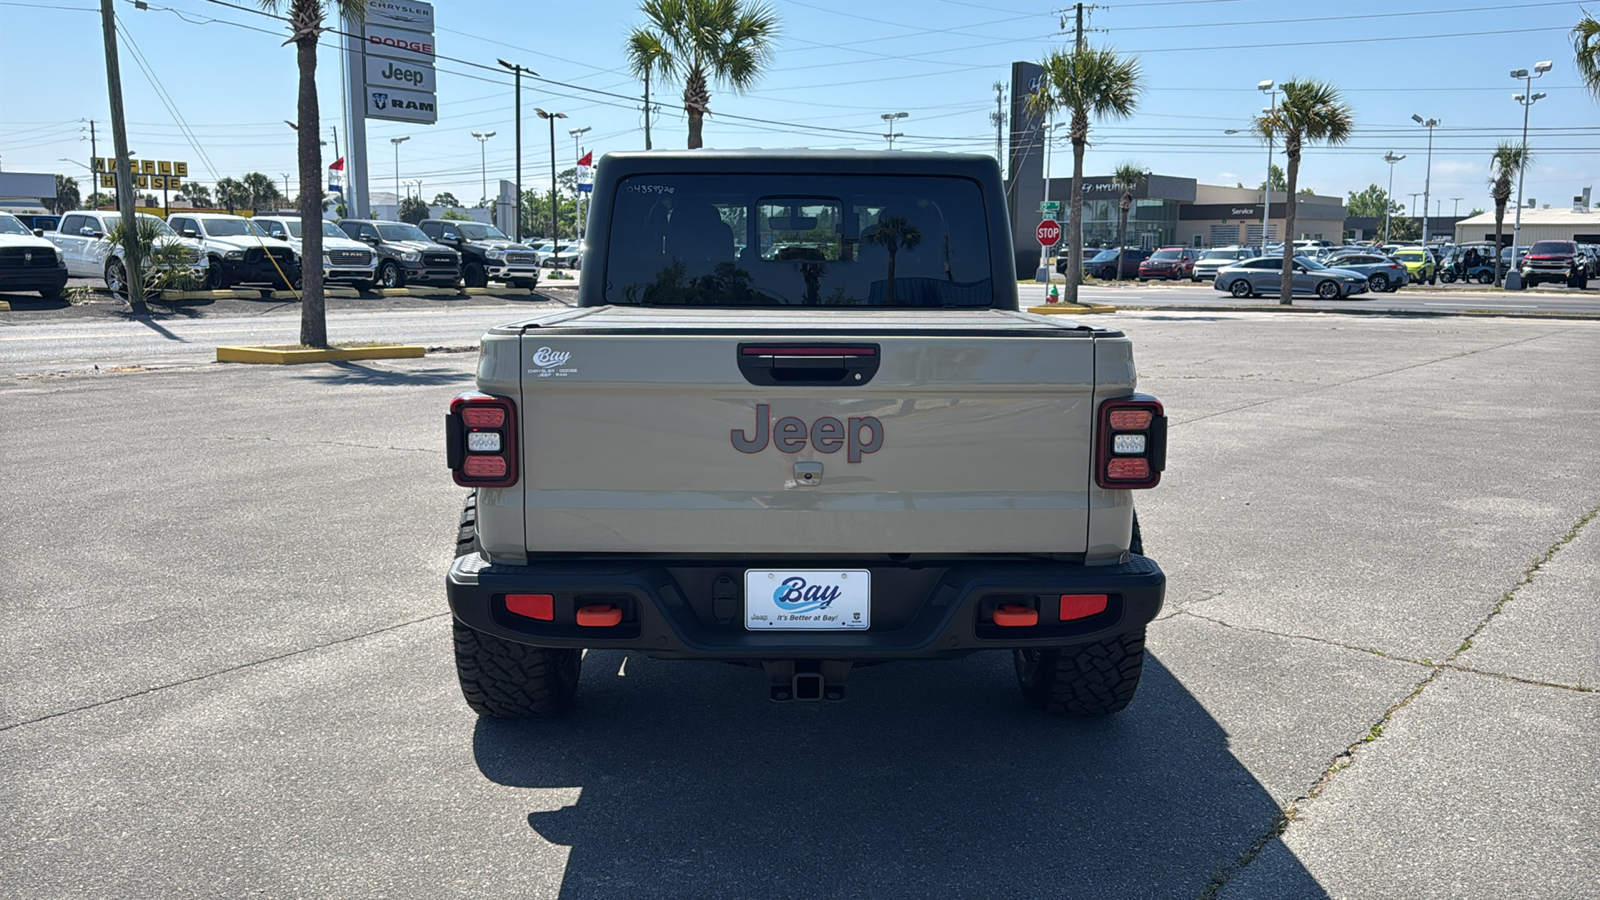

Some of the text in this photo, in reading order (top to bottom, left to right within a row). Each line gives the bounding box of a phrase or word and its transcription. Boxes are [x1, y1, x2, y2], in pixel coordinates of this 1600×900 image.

[369, 1, 430, 16] CHRYSLER
[369, 35, 432, 53] DODGE
[381, 62, 424, 86] Jeep
[391, 98, 434, 112] RAM
[104, 175, 179, 189] HUSE
[1231, 207, 1254, 215] Service
[1038, 227, 1060, 239] STOP
[535, 346, 572, 367] Bay
[730, 403, 884, 464] Jeep
[777, 576, 842, 610] Bay
[822, 614, 838, 622] Bay!
